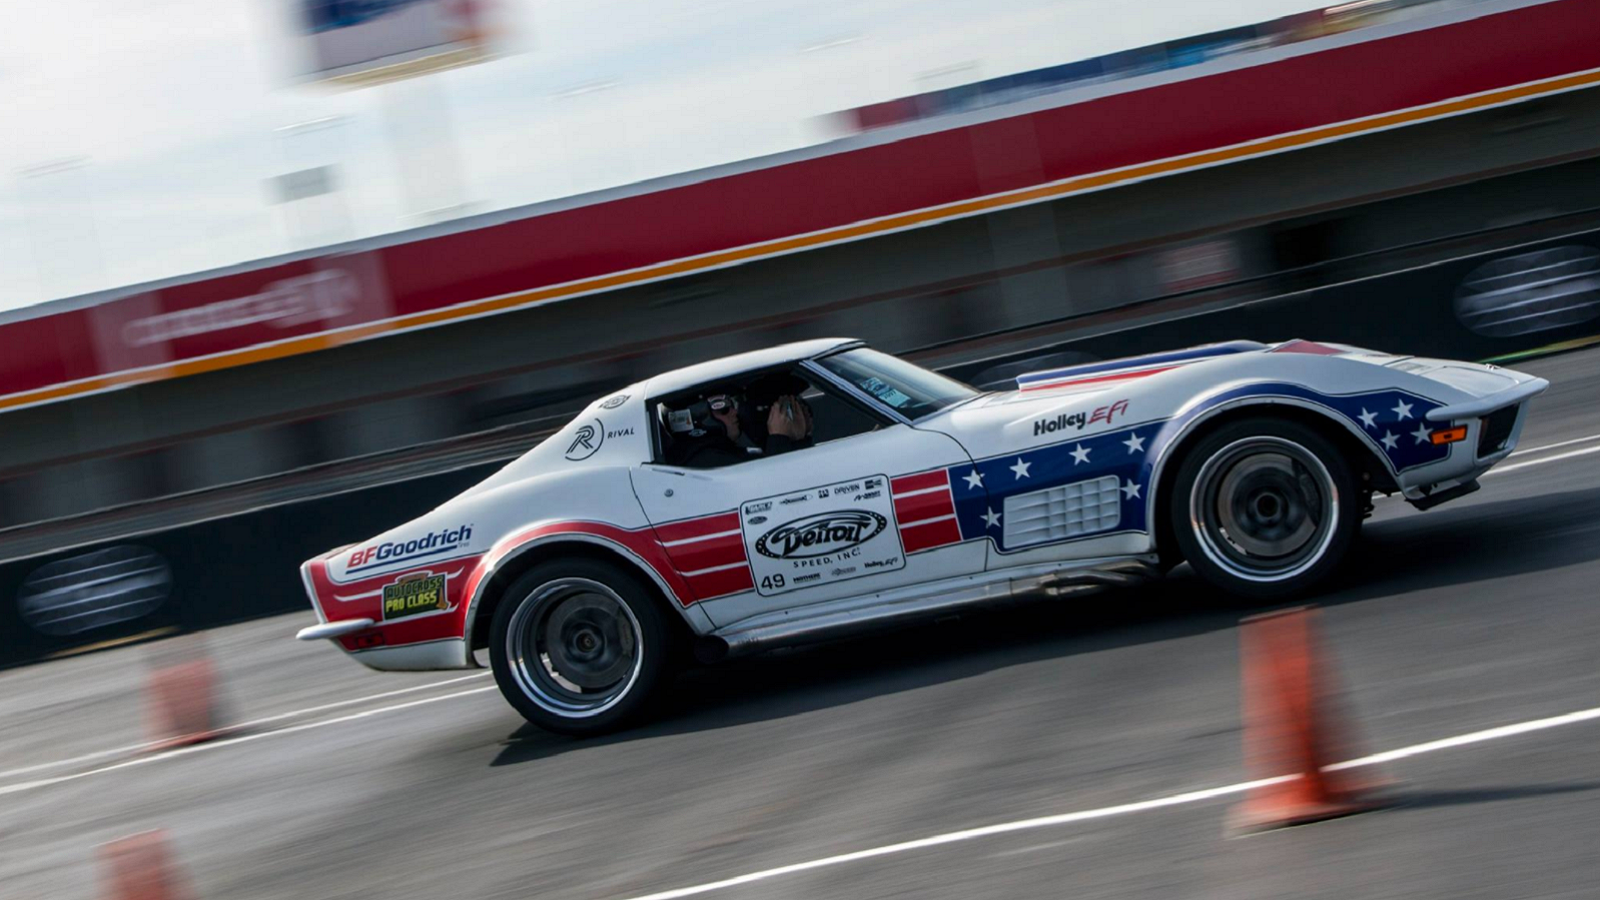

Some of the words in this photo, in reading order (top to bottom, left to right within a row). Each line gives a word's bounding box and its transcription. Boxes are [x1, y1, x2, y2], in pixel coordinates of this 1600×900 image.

[607, 427, 635, 439] RIVAL
[1033, 411, 1086, 437] Holley
[834, 484, 860, 494] DRIVEN
[347, 525, 472, 568] BFGoodrich
[770, 517, 871, 558] Detroit
[793, 556, 833, 568] SPEED,
[386, 577, 442, 598] AUTOCROSS
[761, 573, 786, 590] 49
[386, 599, 405, 613] PRO
[407, 590, 437, 608] CLASS
